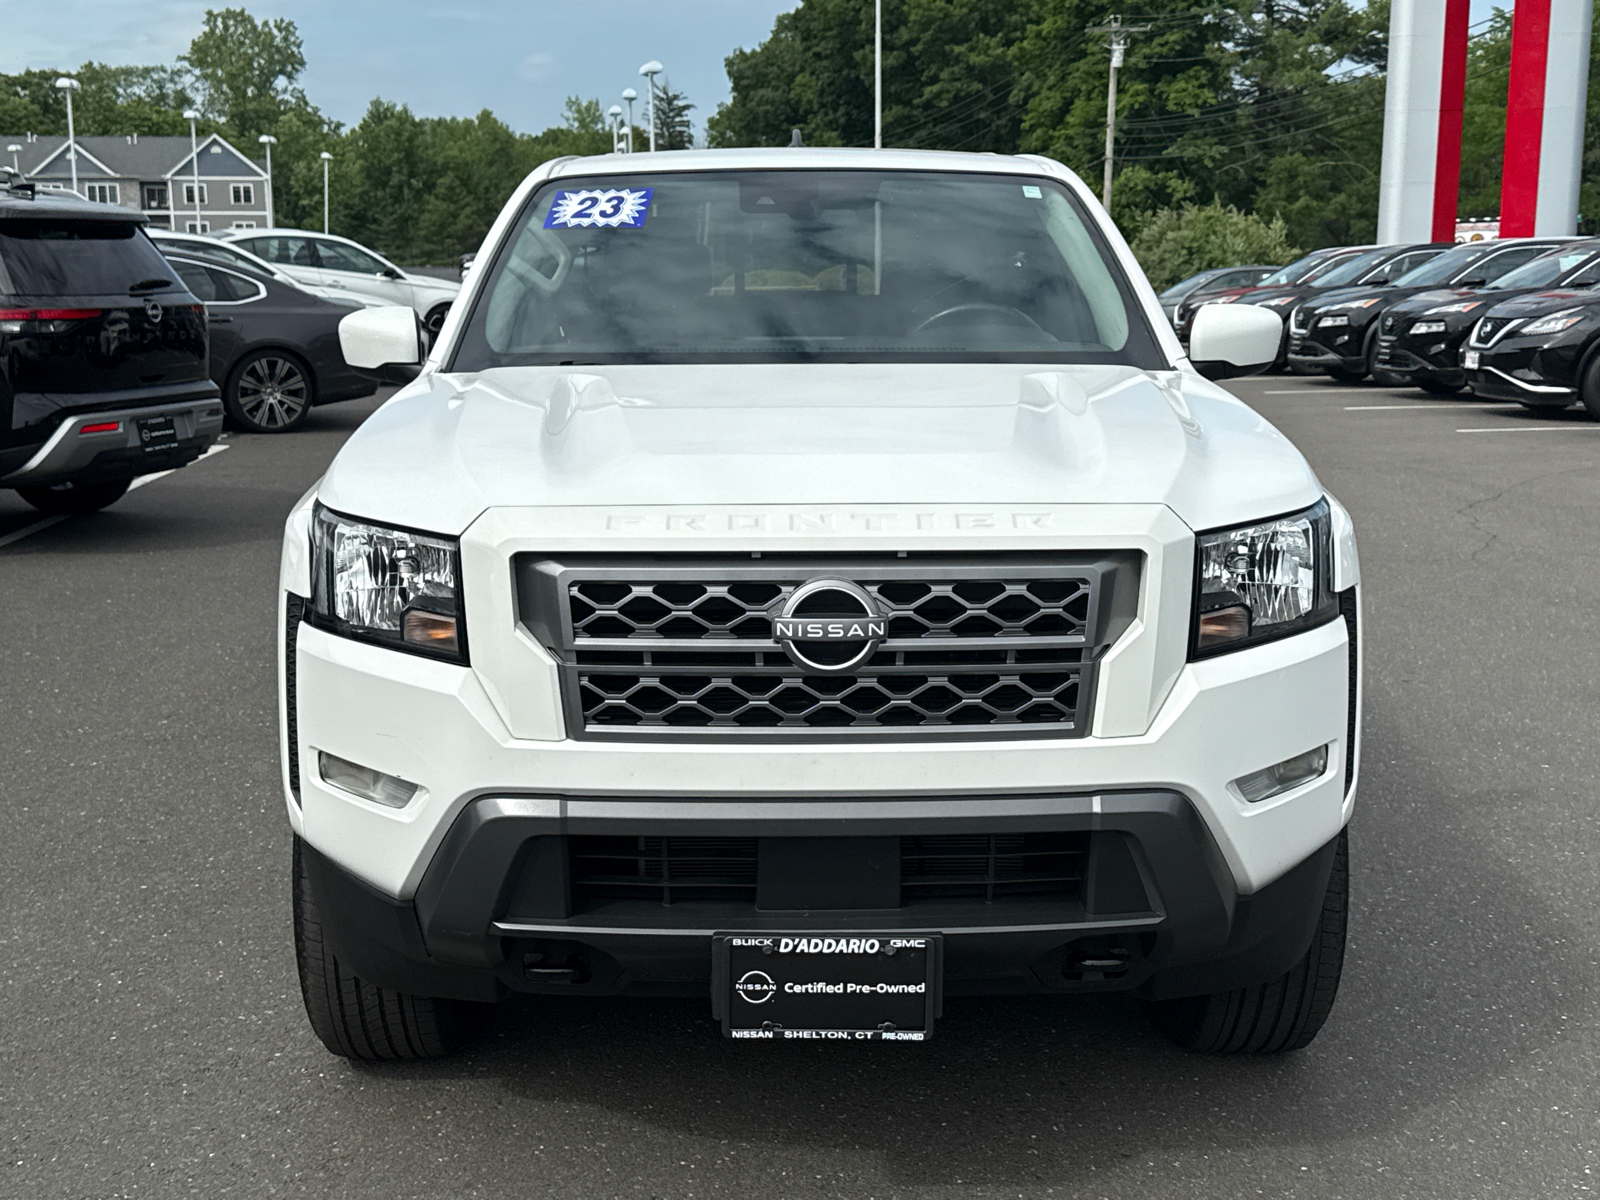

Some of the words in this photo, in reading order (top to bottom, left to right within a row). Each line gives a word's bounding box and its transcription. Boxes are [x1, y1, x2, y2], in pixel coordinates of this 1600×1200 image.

[570, 196, 628, 219] 23
[605, 511, 1054, 531] FRONTIER
[776, 622, 885, 637] NISSAN
[732, 938, 773, 946] BUICK
[779, 938, 880, 954] D'ADDARIO
[890, 939, 926, 948] GMC
[736, 983, 777, 991] NISSAN
[784, 981, 843, 994] Certified
[847, 982, 926, 994] Pre-Owned
[732, 1031, 773, 1039] NISSAN
[784, 1031, 852, 1040] SHELTON,
[855, 1031, 874, 1039] CT
[882, 1032, 924, 1040] PRE-OWNED
